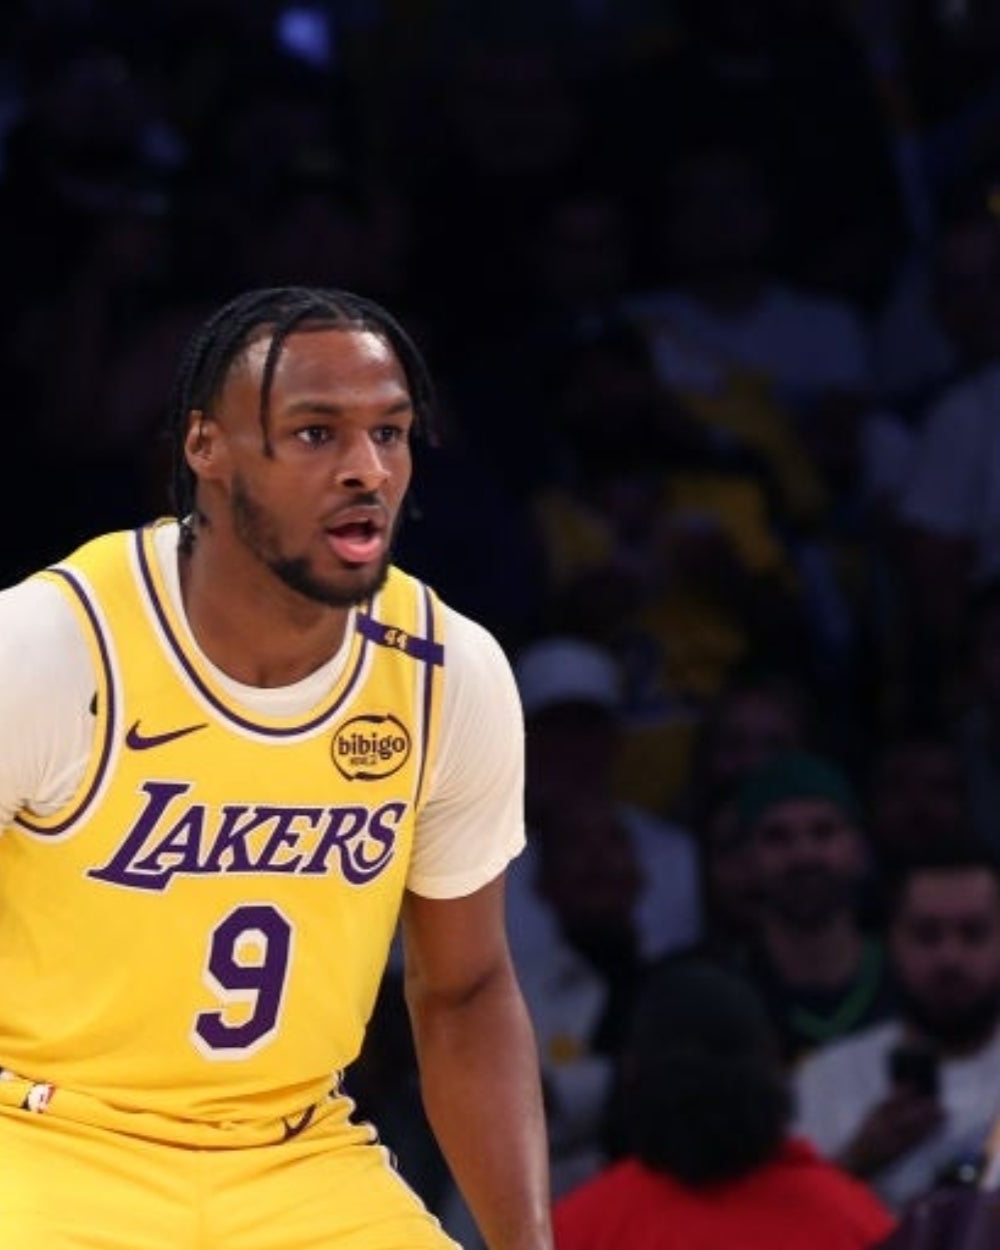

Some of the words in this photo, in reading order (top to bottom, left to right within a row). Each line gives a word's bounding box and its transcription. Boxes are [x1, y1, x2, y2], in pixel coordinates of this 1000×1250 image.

[337, 732, 405, 760] bibigo
[87, 781, 407, 891] LAKERS
[195, 904, 292, 1050] 9
